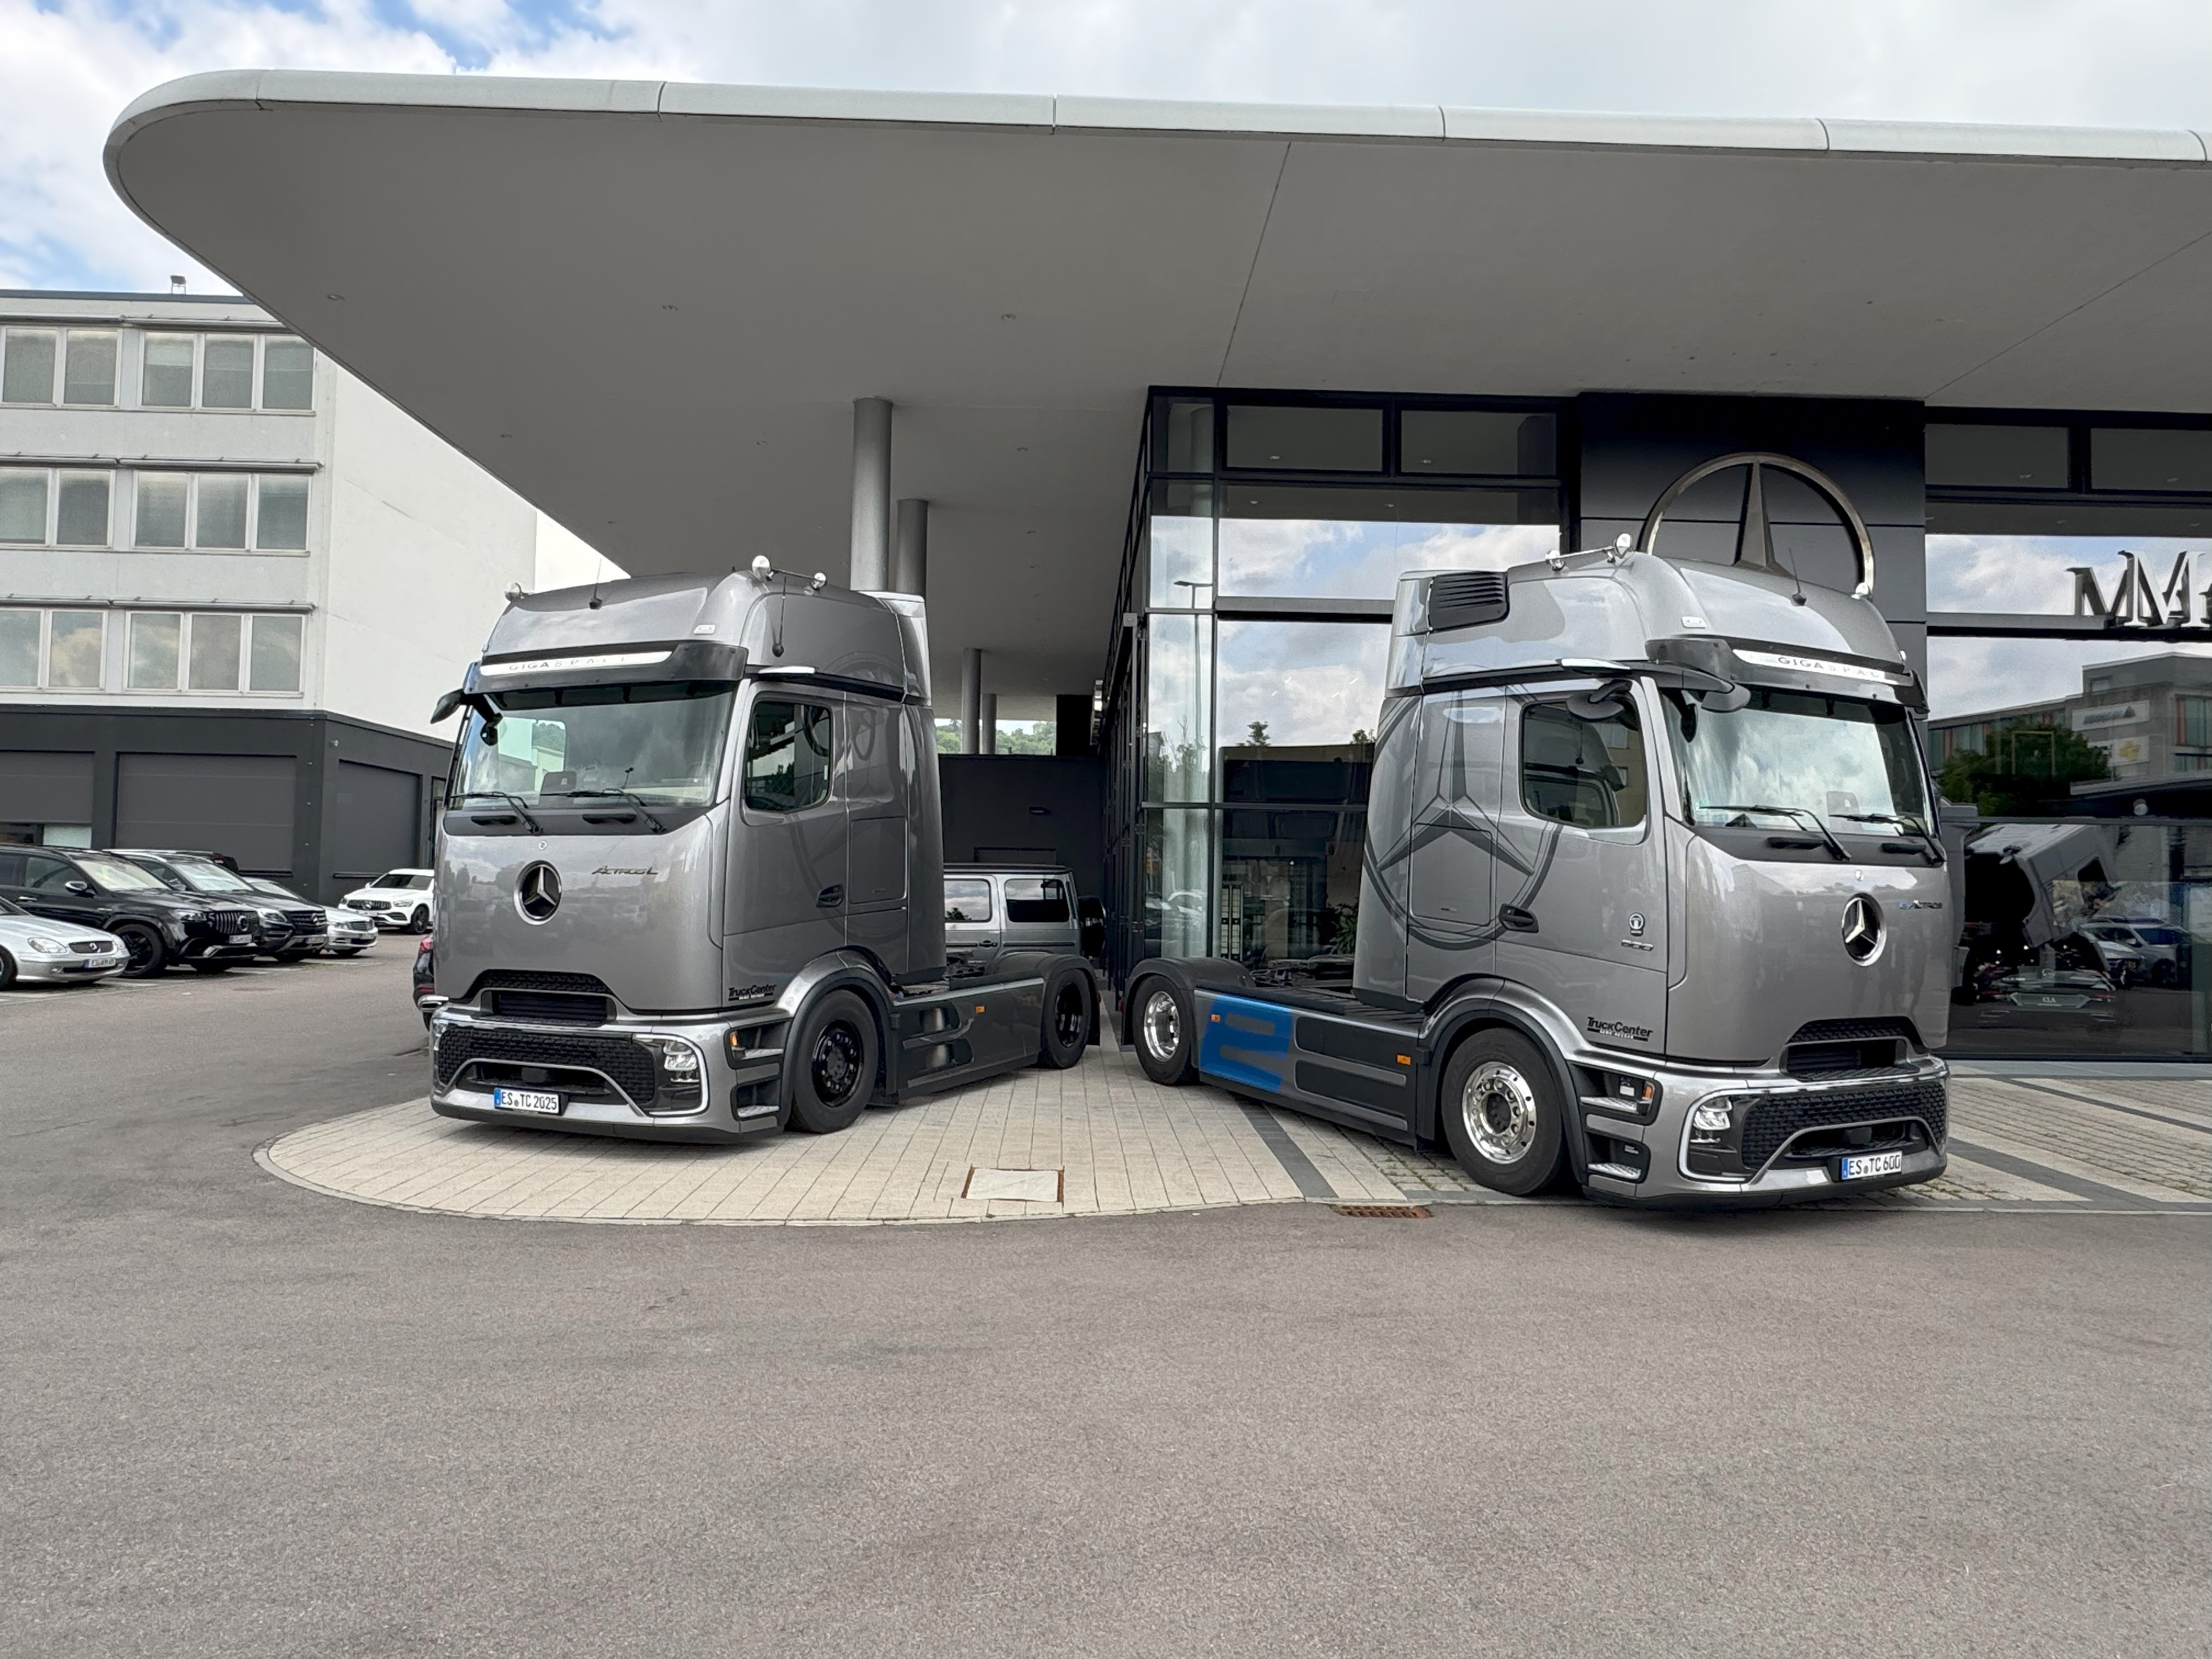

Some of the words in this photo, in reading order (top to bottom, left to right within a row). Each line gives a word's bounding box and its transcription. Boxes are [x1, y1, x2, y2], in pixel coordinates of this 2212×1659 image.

[501, 1092, 513, 1105] ES
[520, 1093, 531, 1107] TC
[533, 1095, 557, 1110] 2025
[1849, 1160, 1862, 1176] ES
[1869, 1157, 1881, 1172] TC
[1883, 1154, 1900, 1171] 600
